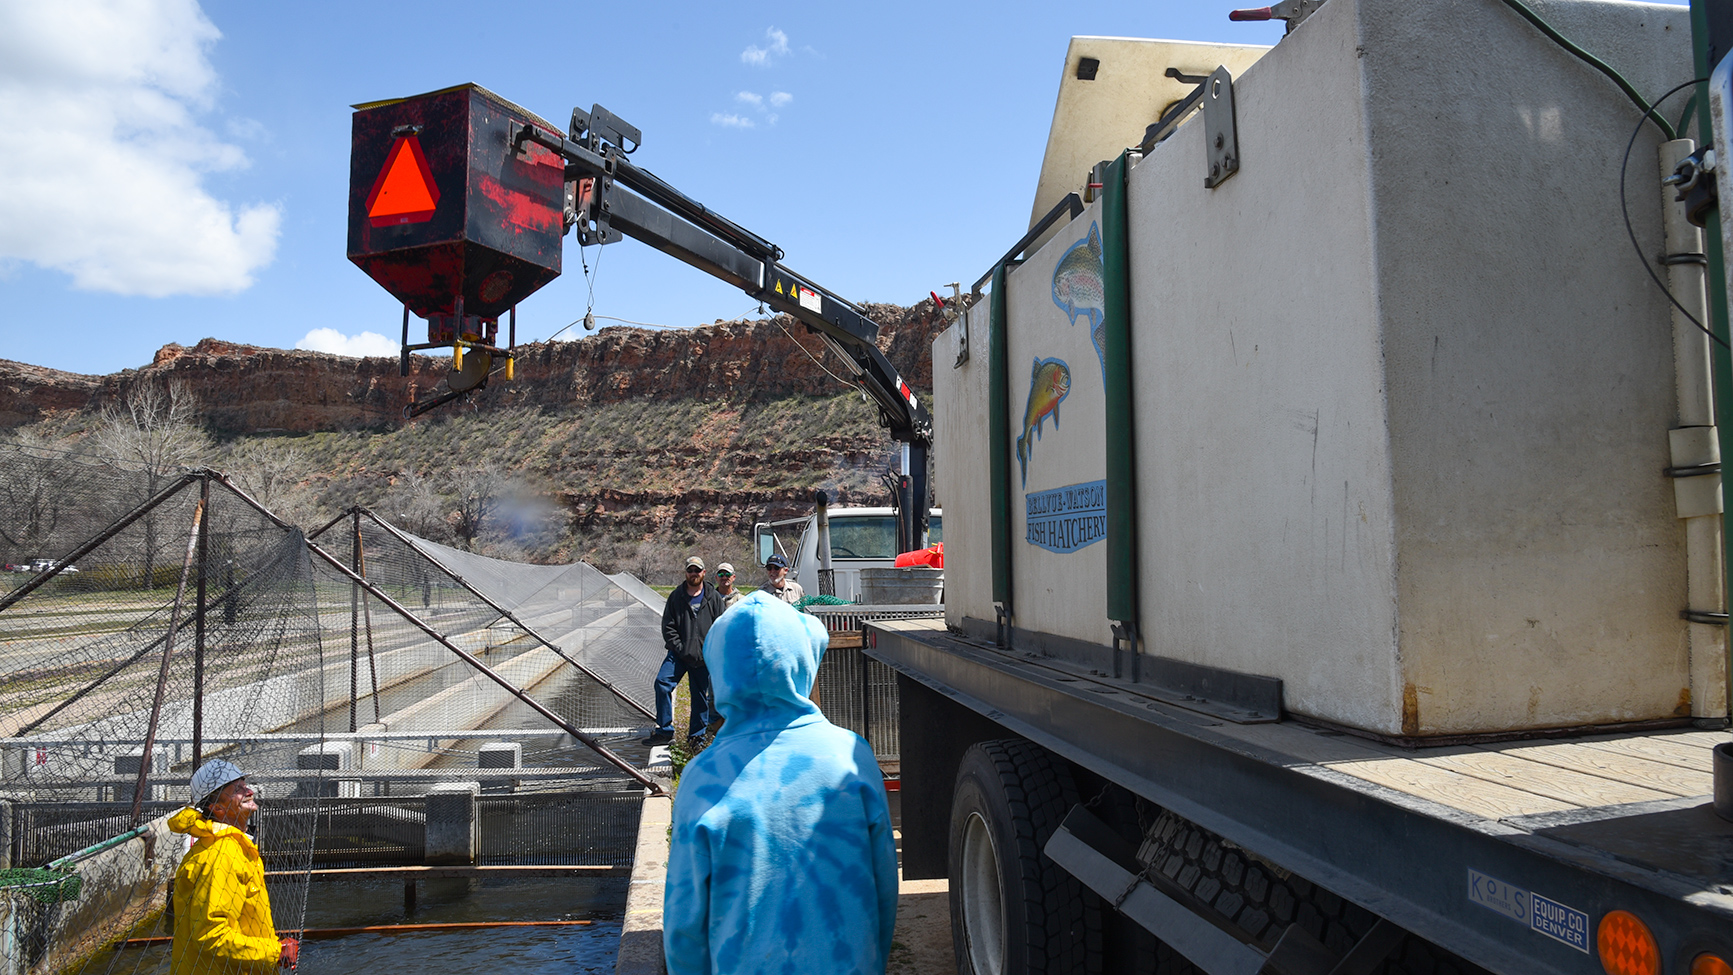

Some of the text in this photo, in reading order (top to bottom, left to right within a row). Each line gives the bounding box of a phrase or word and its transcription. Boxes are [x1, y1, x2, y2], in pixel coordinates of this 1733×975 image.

[1028, 516, 1106, 549] FISH HATCHERY
[1534, 898, 1585, 934] EQUIP. CO.
[1536, 916, 1583, 945] DENVER
